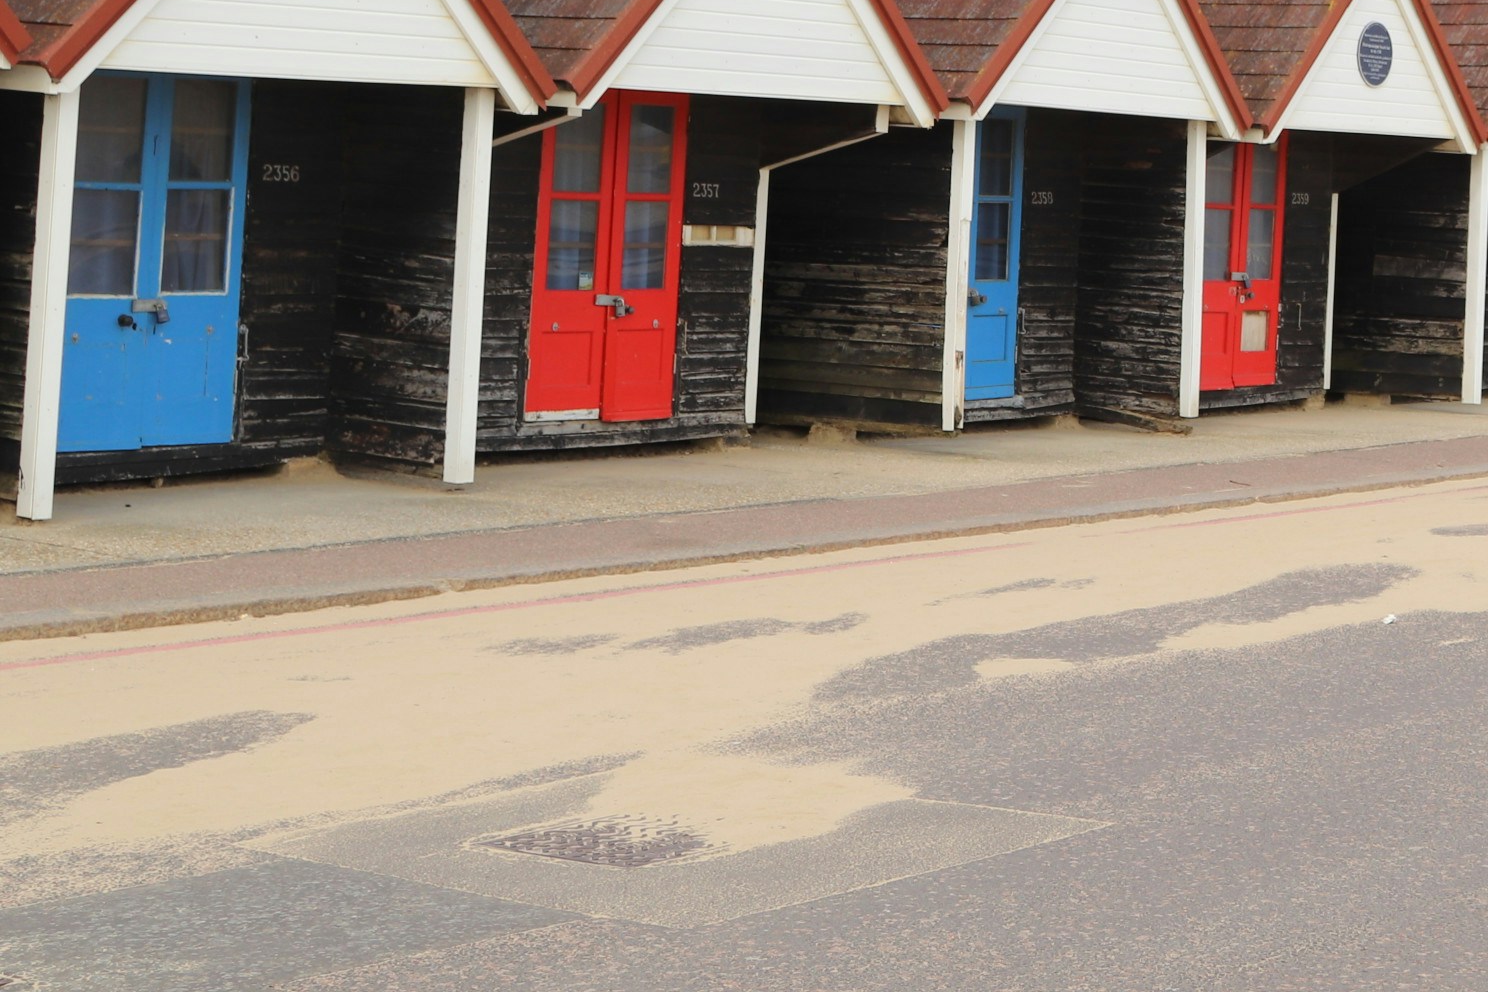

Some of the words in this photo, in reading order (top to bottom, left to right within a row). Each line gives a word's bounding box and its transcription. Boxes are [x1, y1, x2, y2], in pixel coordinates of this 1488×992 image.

[262, 164, 300, 182] 2356
[692, 182, 720, 198] 2357
[1031, 191, 1054, 205] 2358
[1291, 192, 1309, 205] 2359
